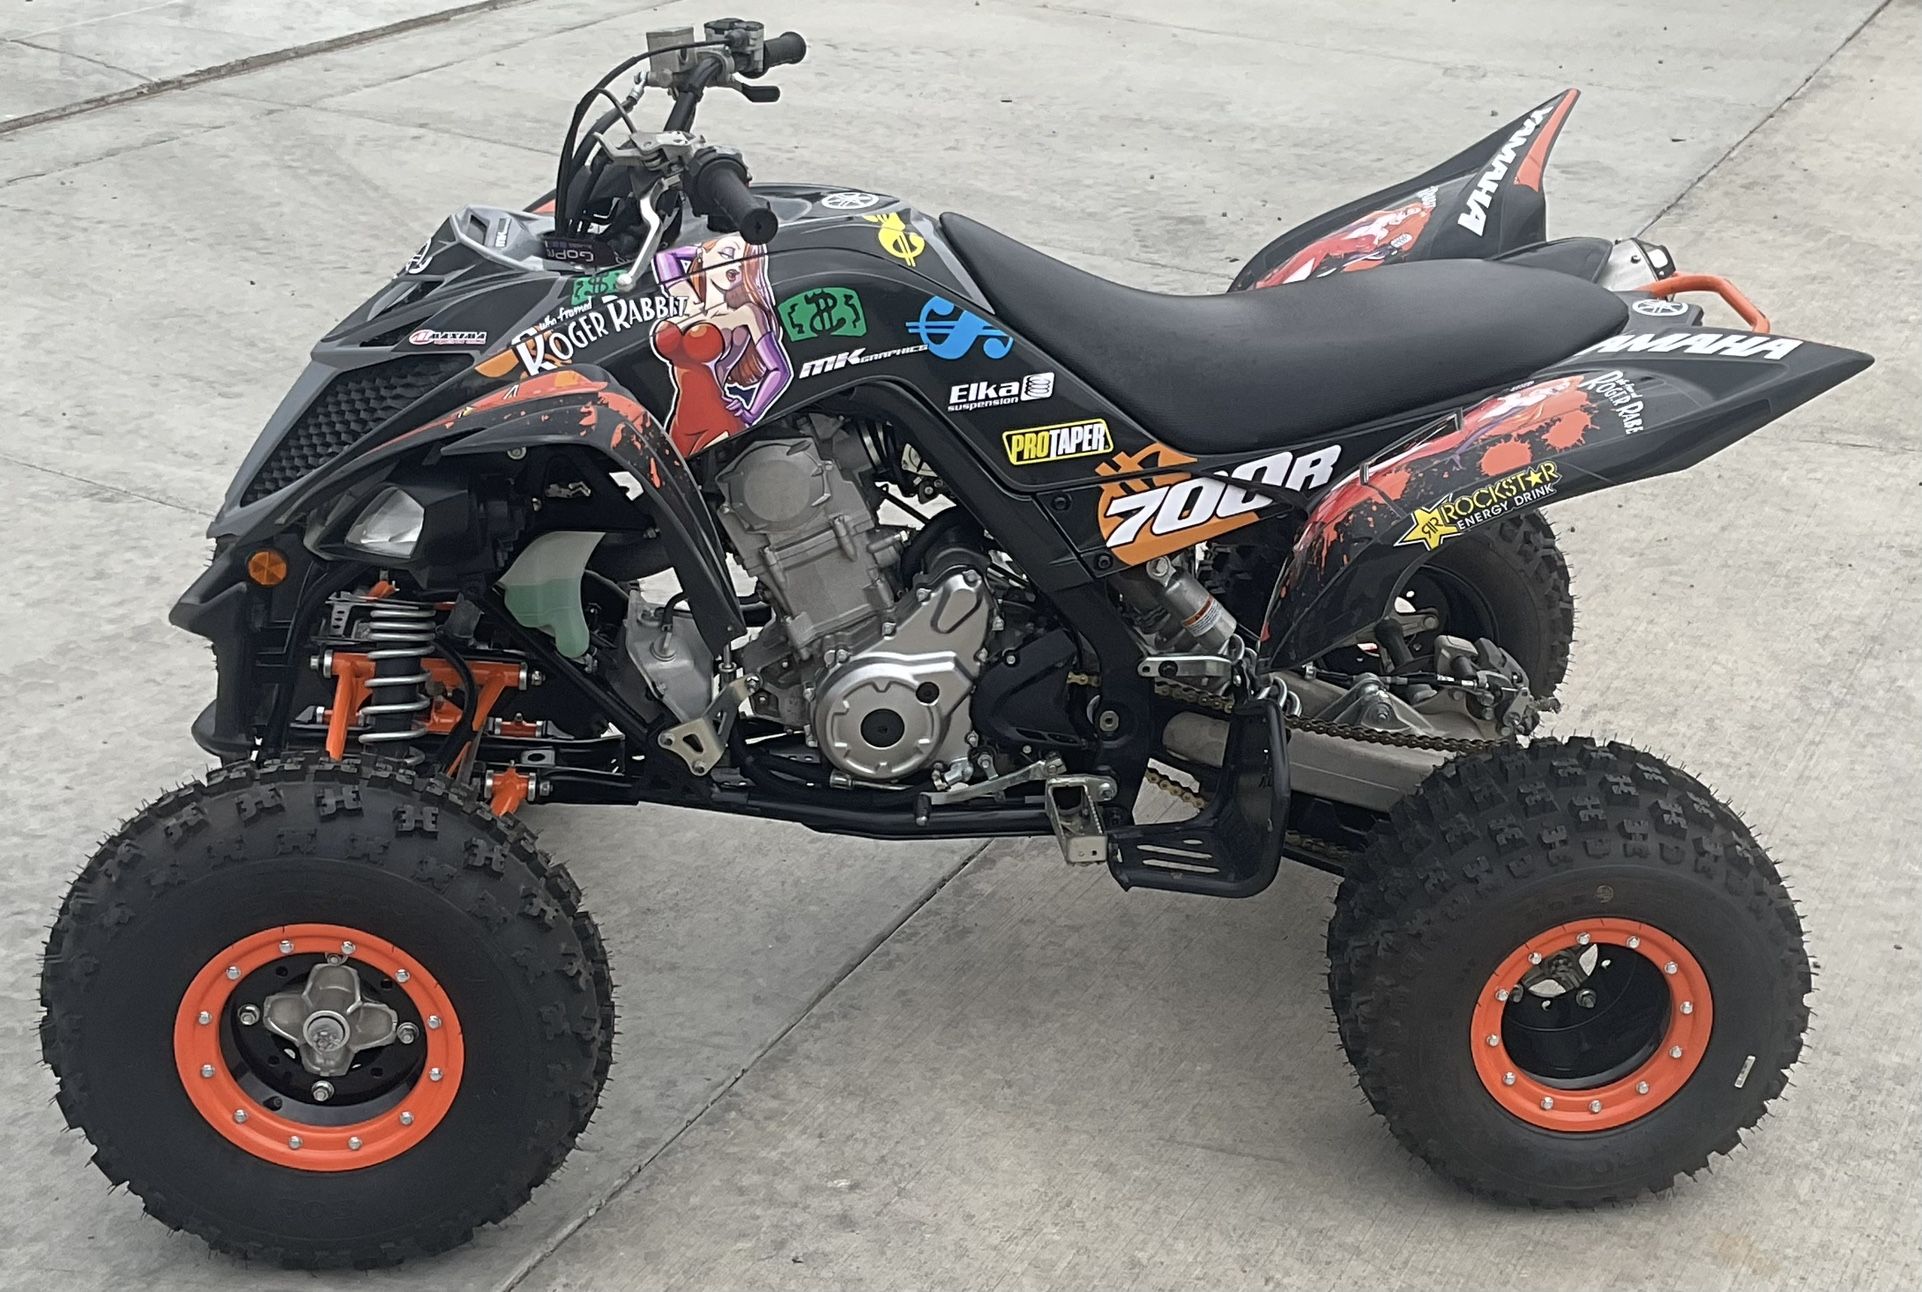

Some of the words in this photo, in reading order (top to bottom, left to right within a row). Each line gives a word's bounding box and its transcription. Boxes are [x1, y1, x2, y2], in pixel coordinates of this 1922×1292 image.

[1457, 106, 1554, 236] YAMAHA
[511, 310, 609, 376] ROGER
[602, 295, 689, 333] RABBIT
[1573, 332, 1804, 360] AMAHA
[947, 396, 1019, 412] suspension
[949, 381, 1020, 405] Elka
[1577, 369, 1632, 407] ROGER
[1011, 423, 1106, 462] PROTAPER
[1106, 444, 1342, 548] 700R
[1456, 501, 1509, 531] ENERGY
[1514, 483, 1556, 507] DRINK
